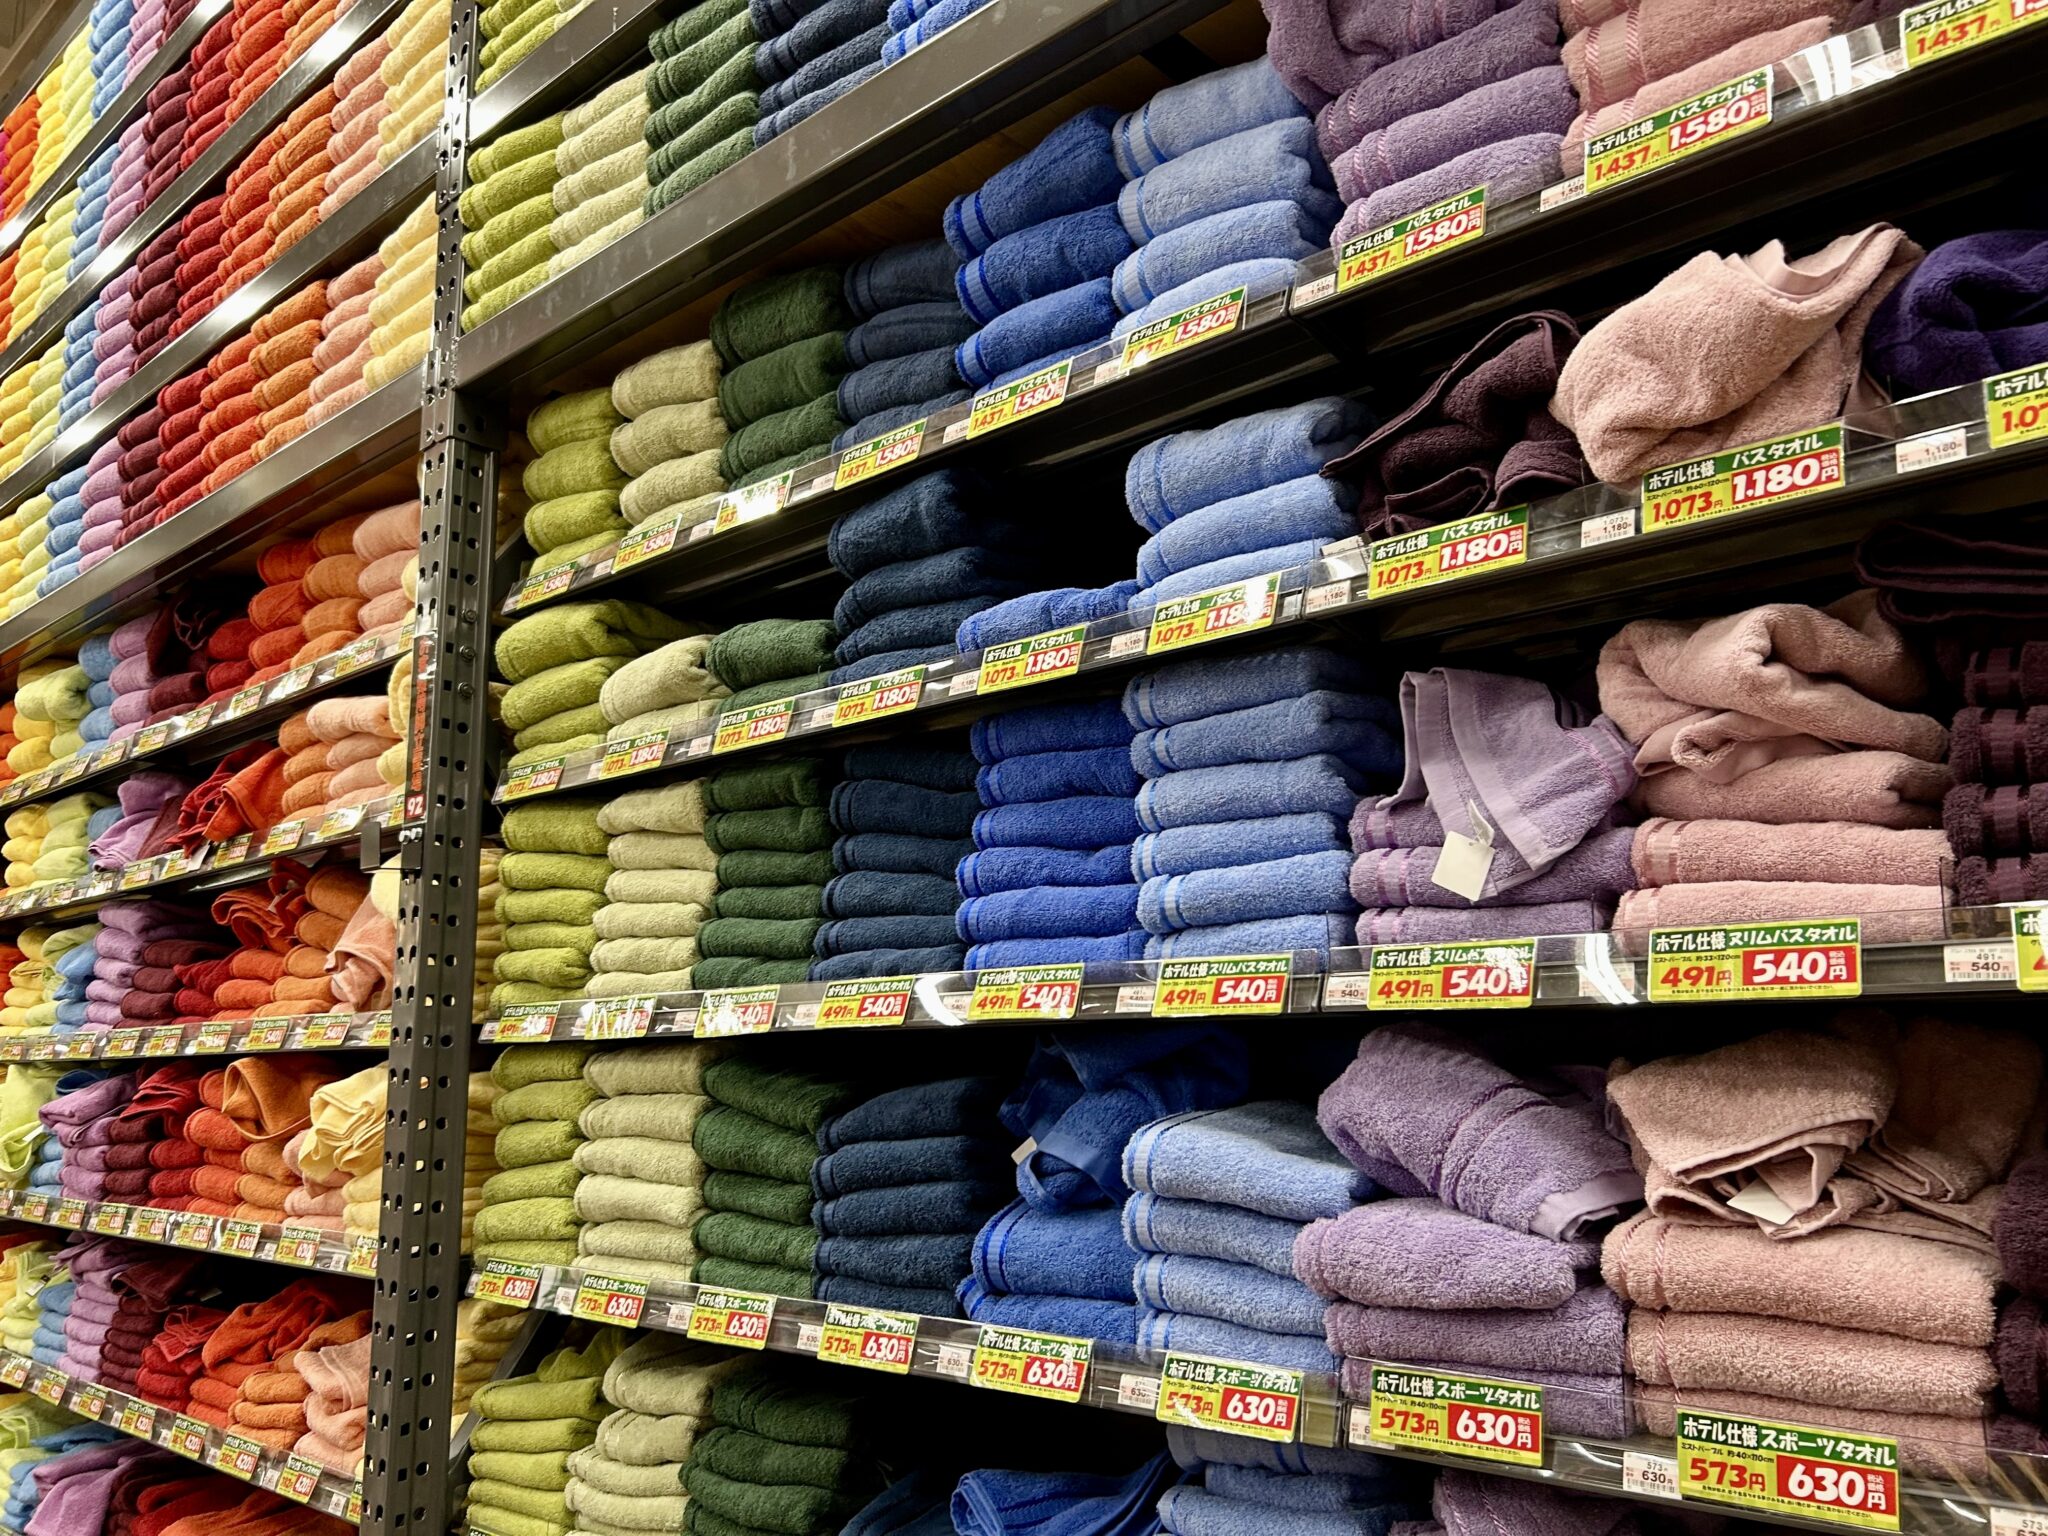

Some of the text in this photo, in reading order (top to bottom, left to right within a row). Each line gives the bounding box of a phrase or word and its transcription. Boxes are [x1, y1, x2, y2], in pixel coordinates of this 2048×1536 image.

[1591, 119, 1655, 154] ホテル仕様
[1344, 227, 1395, 258] ホテル仕様
[1406, 196, 1472, 231] バスタオル
[1130, 295, 1231, 343] ホテル仕様 バスタオル
[1994, 369, 2048, 398] ホテル
[1648, 434, 1823, 490] ホテル仕様 バスタオル
[1376, 533, 1430, 559] ホテル仕様
[1441, 513, 1512, 541] バスタオル
[1158, 600, 1201, 621] ホテル仕様
[986, 633, 1075, 661] ホテル仕様 バスタオル
[407, 796, 424, 815] 92
[1656, 925, 1856, 952] ホテル仕様 スリムバスタオル
[1164, 960, 1287, 978] ホテル仕様 スリムバスタオル
[1376, 948, 1430, 967] ホテル仕様
[982, 1332, 1021, 1352] ホテル仕様
[1168, 1361, 1215, 1384] ホテル仕様
[1376, 1372, 1541, 1409] ホテル仕様 スポーツタオル
[1380, 1408, 1439, 1436] 573円
[1683, 1418, 1896, 1466] ホテル仕様 スポーツタオル
[1689, 1457, 1766, 1492] 573円
